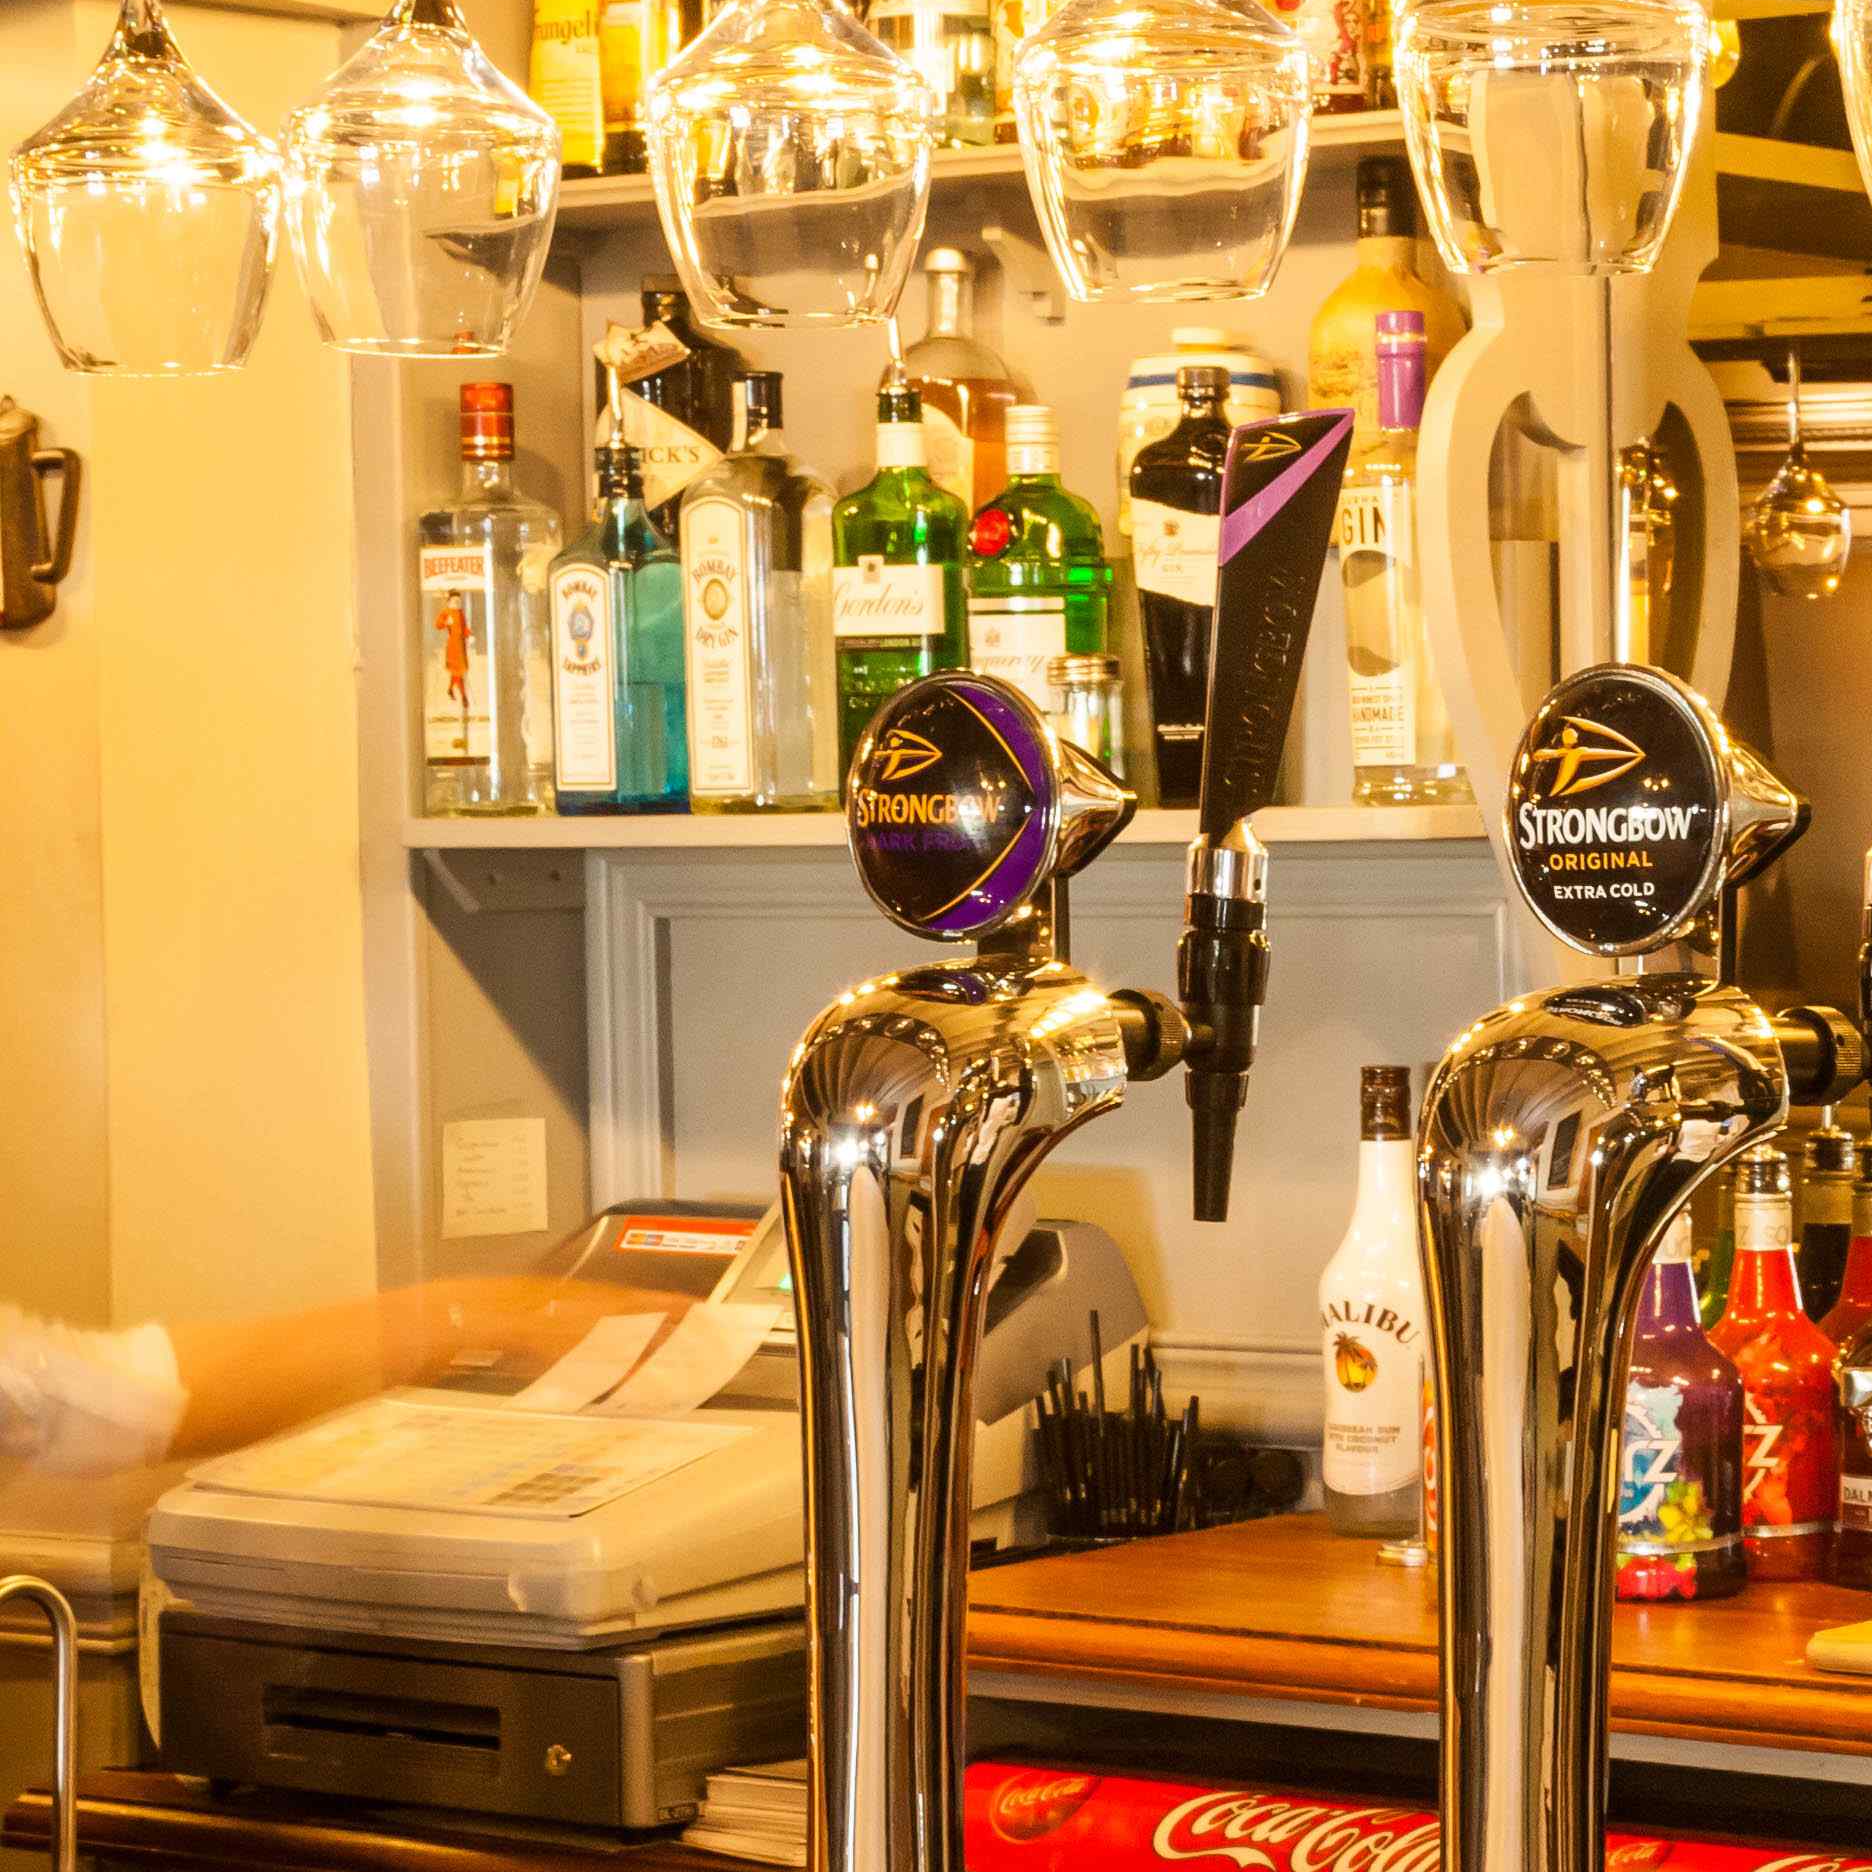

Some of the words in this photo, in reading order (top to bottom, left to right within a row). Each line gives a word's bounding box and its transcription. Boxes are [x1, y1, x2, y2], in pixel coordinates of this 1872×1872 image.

[424, 555, 485, 578] BEEFEATER
[834, 583, 924, 617] Gordon's
[1519, 802, 1693, 850] STRONGBOW
[1549, 851, 1653, 871] ORIGINAL
[1553, 885, 1608, 900] EXTRA
[1609, 882, 1655, 898] COLD
